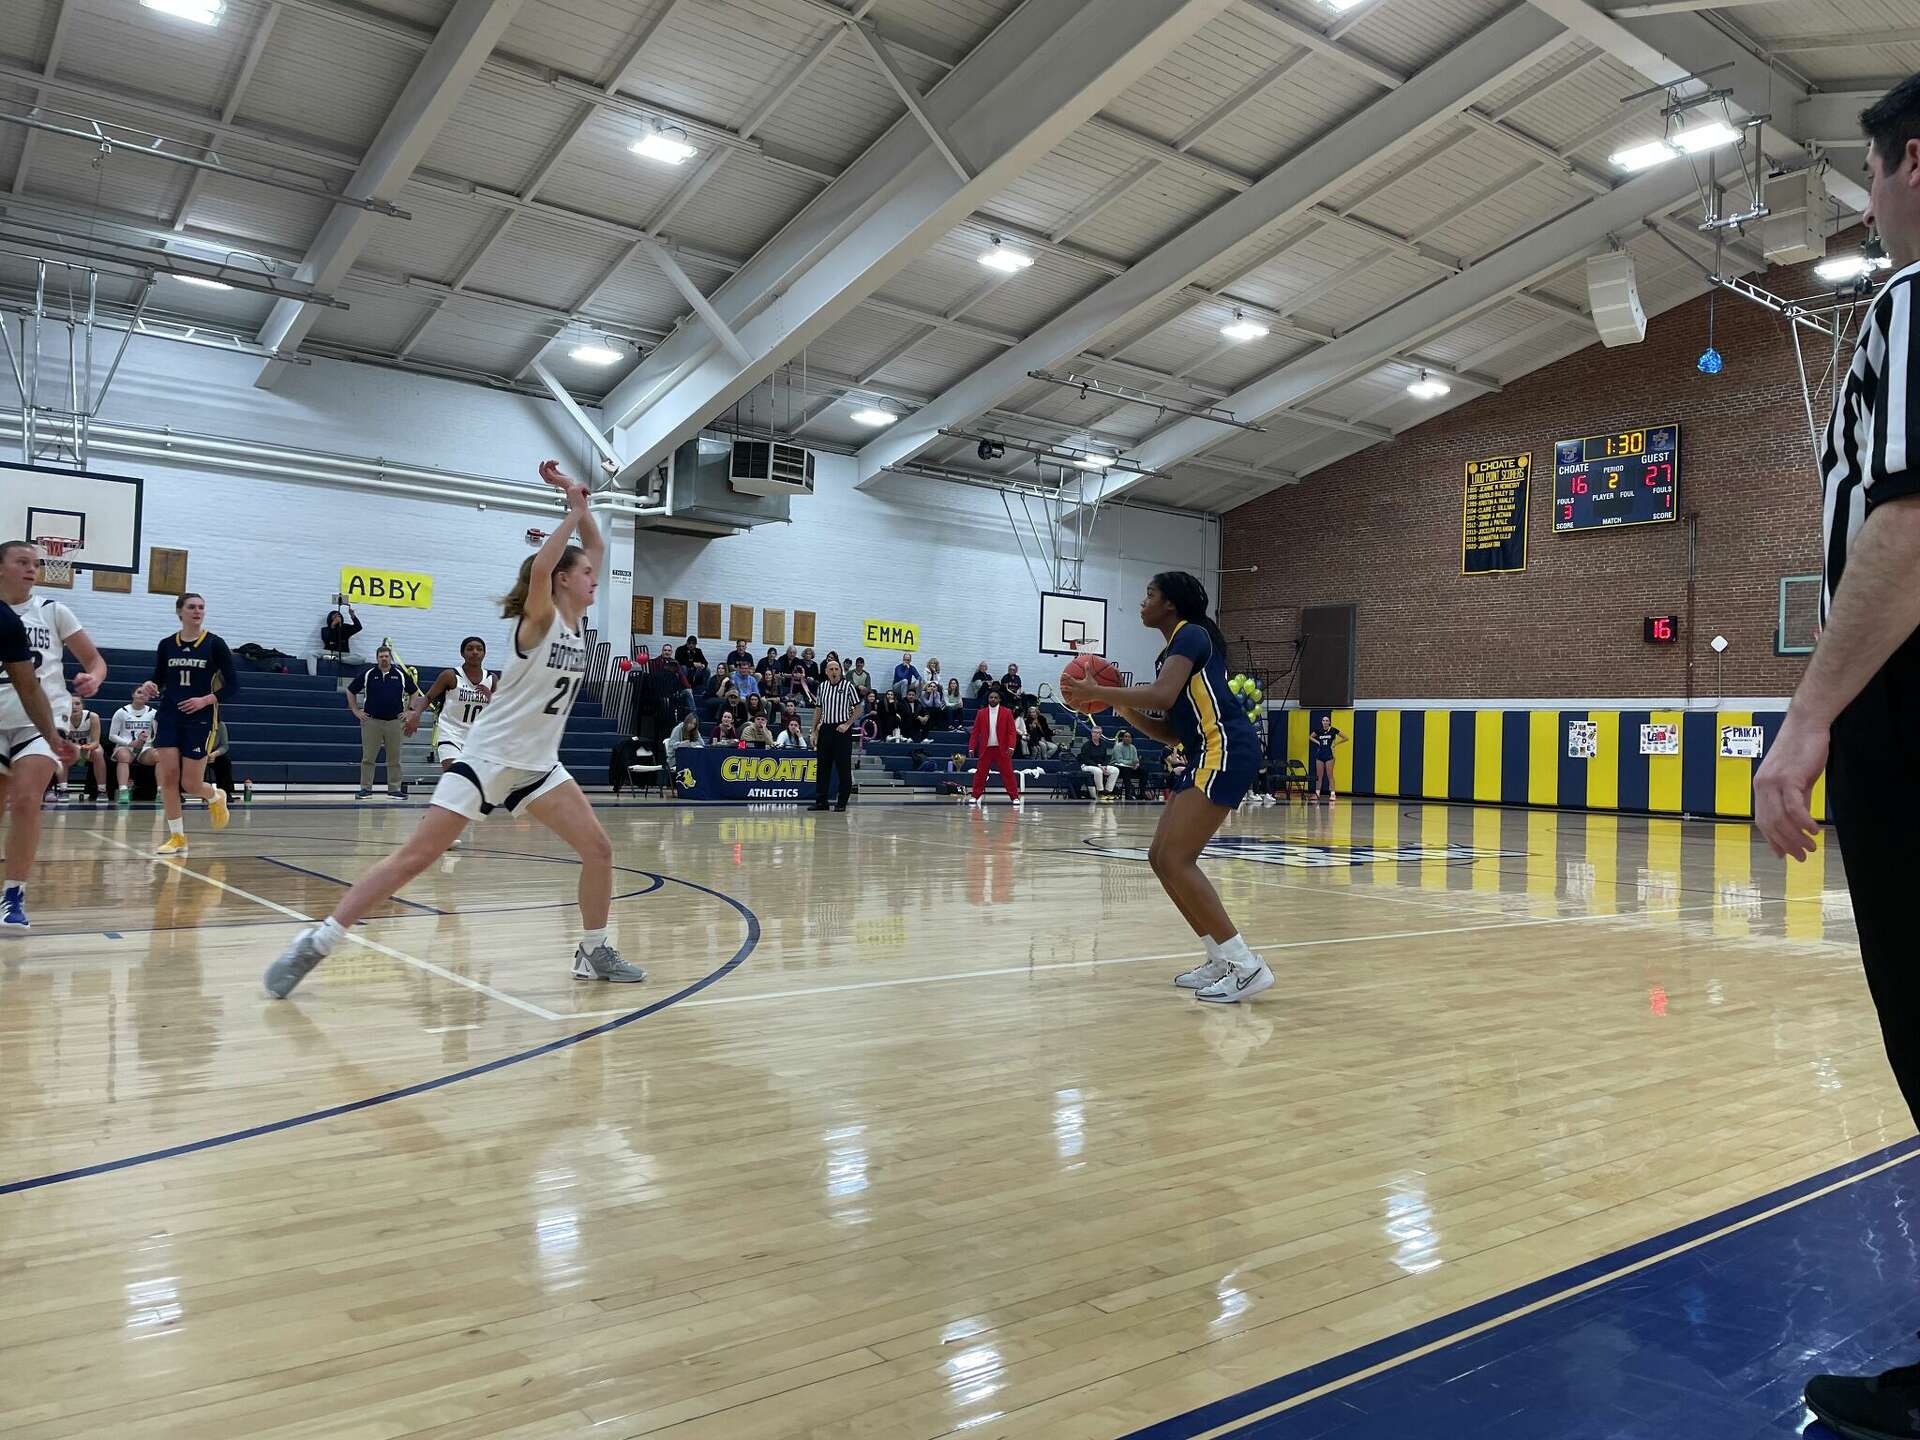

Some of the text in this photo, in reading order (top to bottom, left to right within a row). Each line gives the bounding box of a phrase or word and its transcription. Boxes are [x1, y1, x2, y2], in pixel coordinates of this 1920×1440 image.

[1606, 432, 1642, 455] 1:30
[1641, 452, 1670, 464] GUEST
[1480, 459, 1516, 472] CHOATE
[1558, 463, 1589, 475] CHOATE
[1603, 465, 1624, 474] PERIOD
[1608, 472, 1619, 489] 2
[1645, 464, 1672, 486] 27
[1570, 475, 1589, 494] 16
[1652, 486, 1672, 494] FOULS
[1556, 497, 1575, 505] FOULS
[1592, 490, 1635, 501] PLAYER FOUL
[1665, 494, 1670, 507] 1
[1563, 504, 1573, 520] 3
[1652, 511, 1673, 520] SCORE
[1556, 522, 1574, 530] SCORE
[1602, 517, 1622, 525] MATCH
[348, 575, 422, 601] ABBY
[867, 625, 914, 645] EMMA
[1653, 619, 1671, 639] 16
[168, 658, 208, 669] CHOATE
[179, 670, 191, 687] 11
[1733, 727, 1758, 738] PAIKA
[721, 756, 817, 782] CHOATE
[747, 788, 799, 798] ATHLETICS
